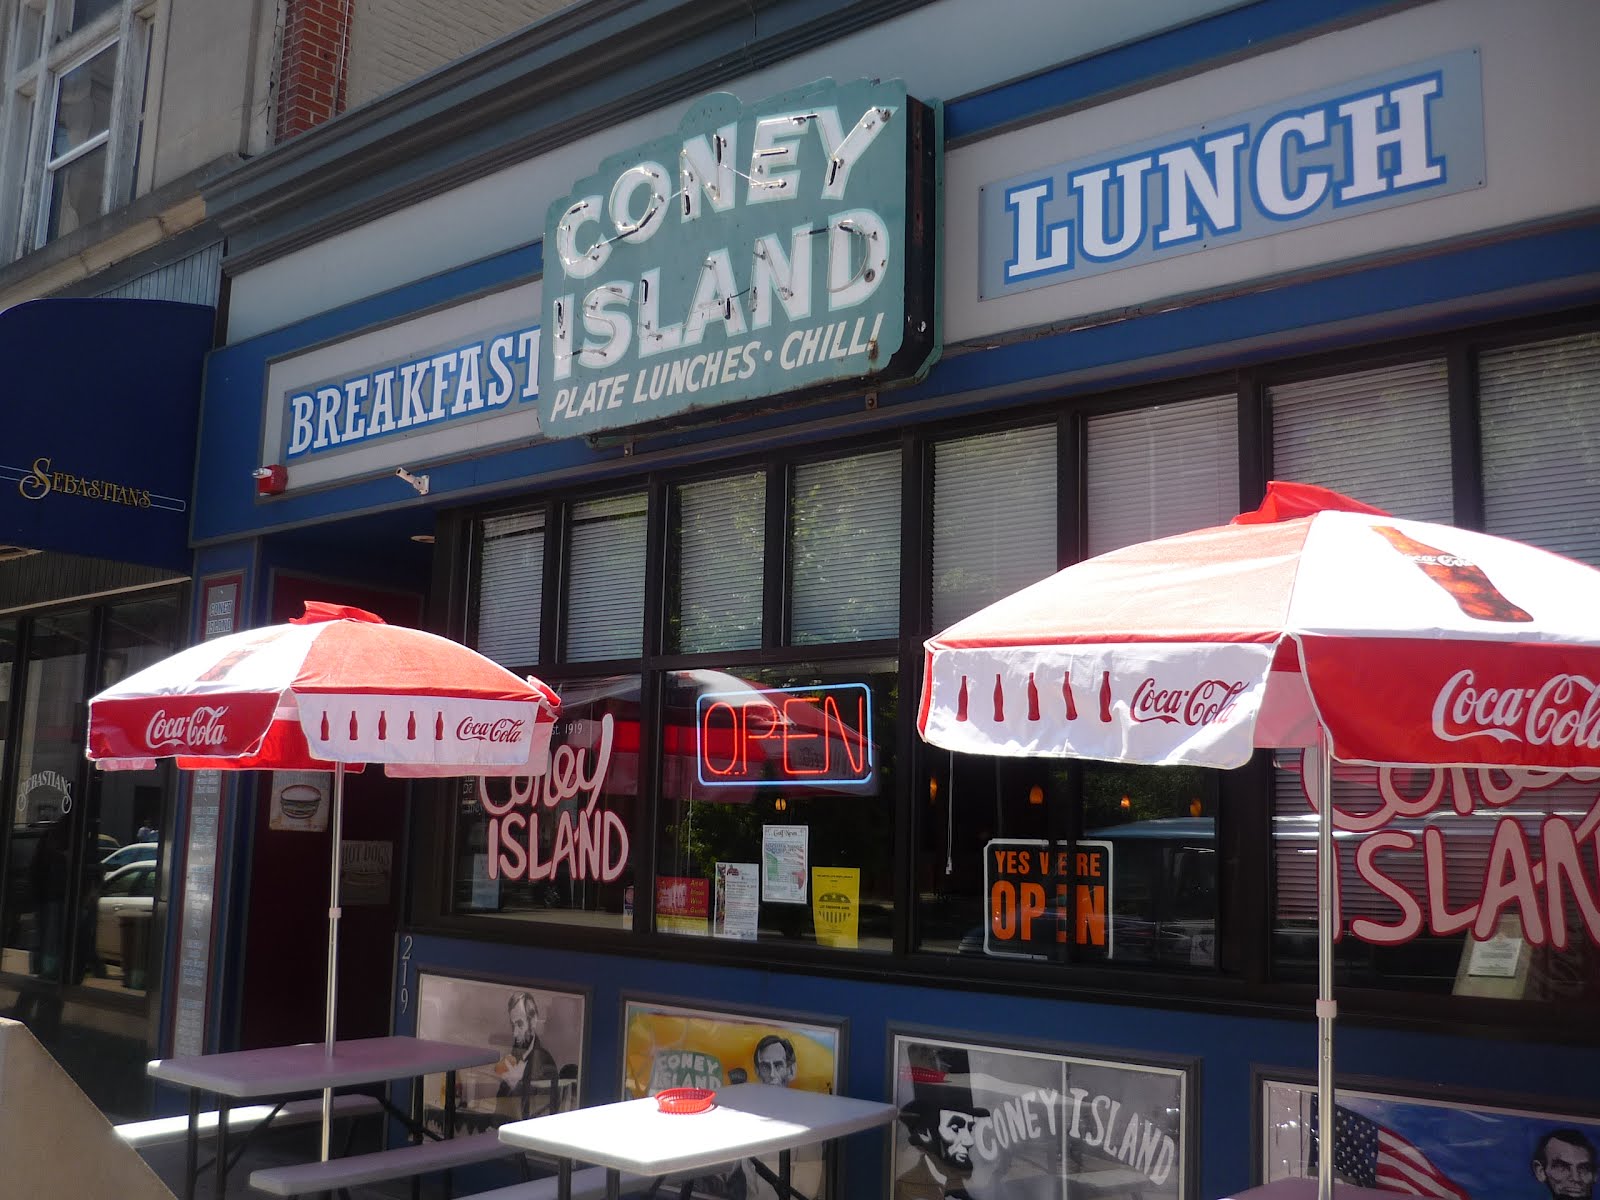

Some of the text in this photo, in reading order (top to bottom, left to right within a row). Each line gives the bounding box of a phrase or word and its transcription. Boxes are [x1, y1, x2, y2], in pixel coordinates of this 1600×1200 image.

[556, 105, 898, 279] CONEY
[1006, 76, 1444, 280] LUNCH
[552, 207, 890, 380] ISLAND
[287, 327, 541, 457] BREAKFAST
[550, 373, 629, 422] PLATE
[633, 341, 761, 409] LUNCHES
[145, 706, 229, 749] Coca-Cola
[456, 716, 525, 743] Coca-Cola
[565, 723, 583, 735] 1919
[704, 695, 864, 775] OPEN
[1129, 677, 1250, 726] Coca-Cola
[487, 809, 630, 885] ISLAND
[995, 851, 1030, 875] YES
[401, 935, 413, 1015] 219
[655, 1053, 719, 1075] CONEY
[975, 1087, 1175, 1186] CONEY ISLAND
